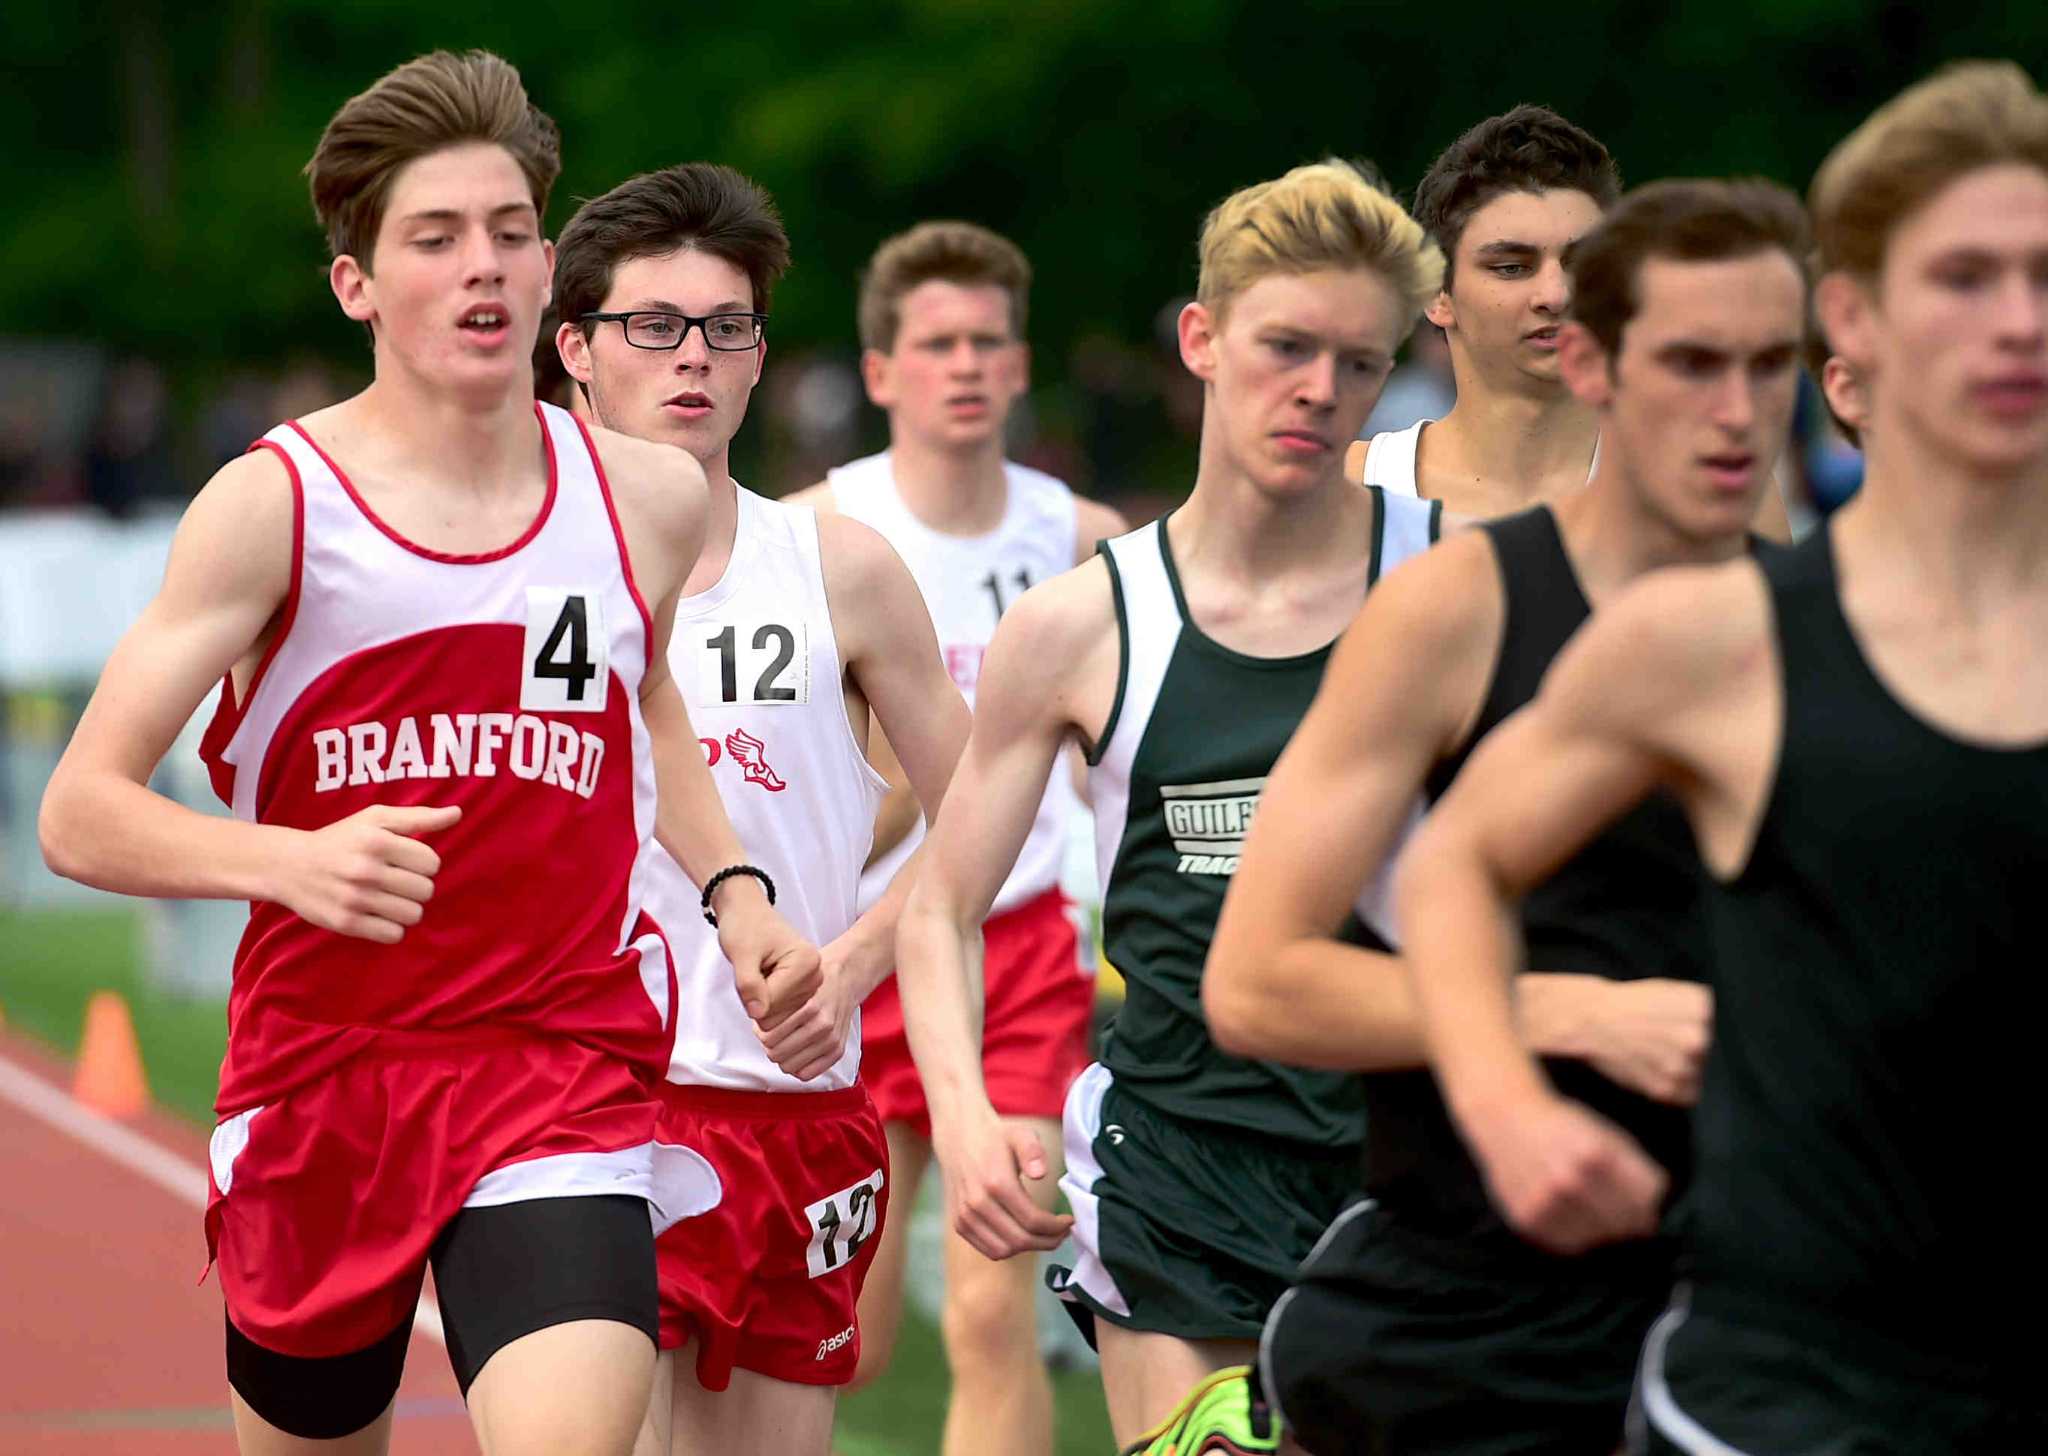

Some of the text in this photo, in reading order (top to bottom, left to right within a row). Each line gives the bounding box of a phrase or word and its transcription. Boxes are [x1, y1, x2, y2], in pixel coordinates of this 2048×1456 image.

[533, 596, 596, 701] 4
[706, 624, 796, 702] 12
[313, 712, 605, 799] BRANFORD
[1171, 800, 1259, 834] GUILF
[1176, 854, 1241, 875] TRAC
[818, 1184, 875, 1269] 12
